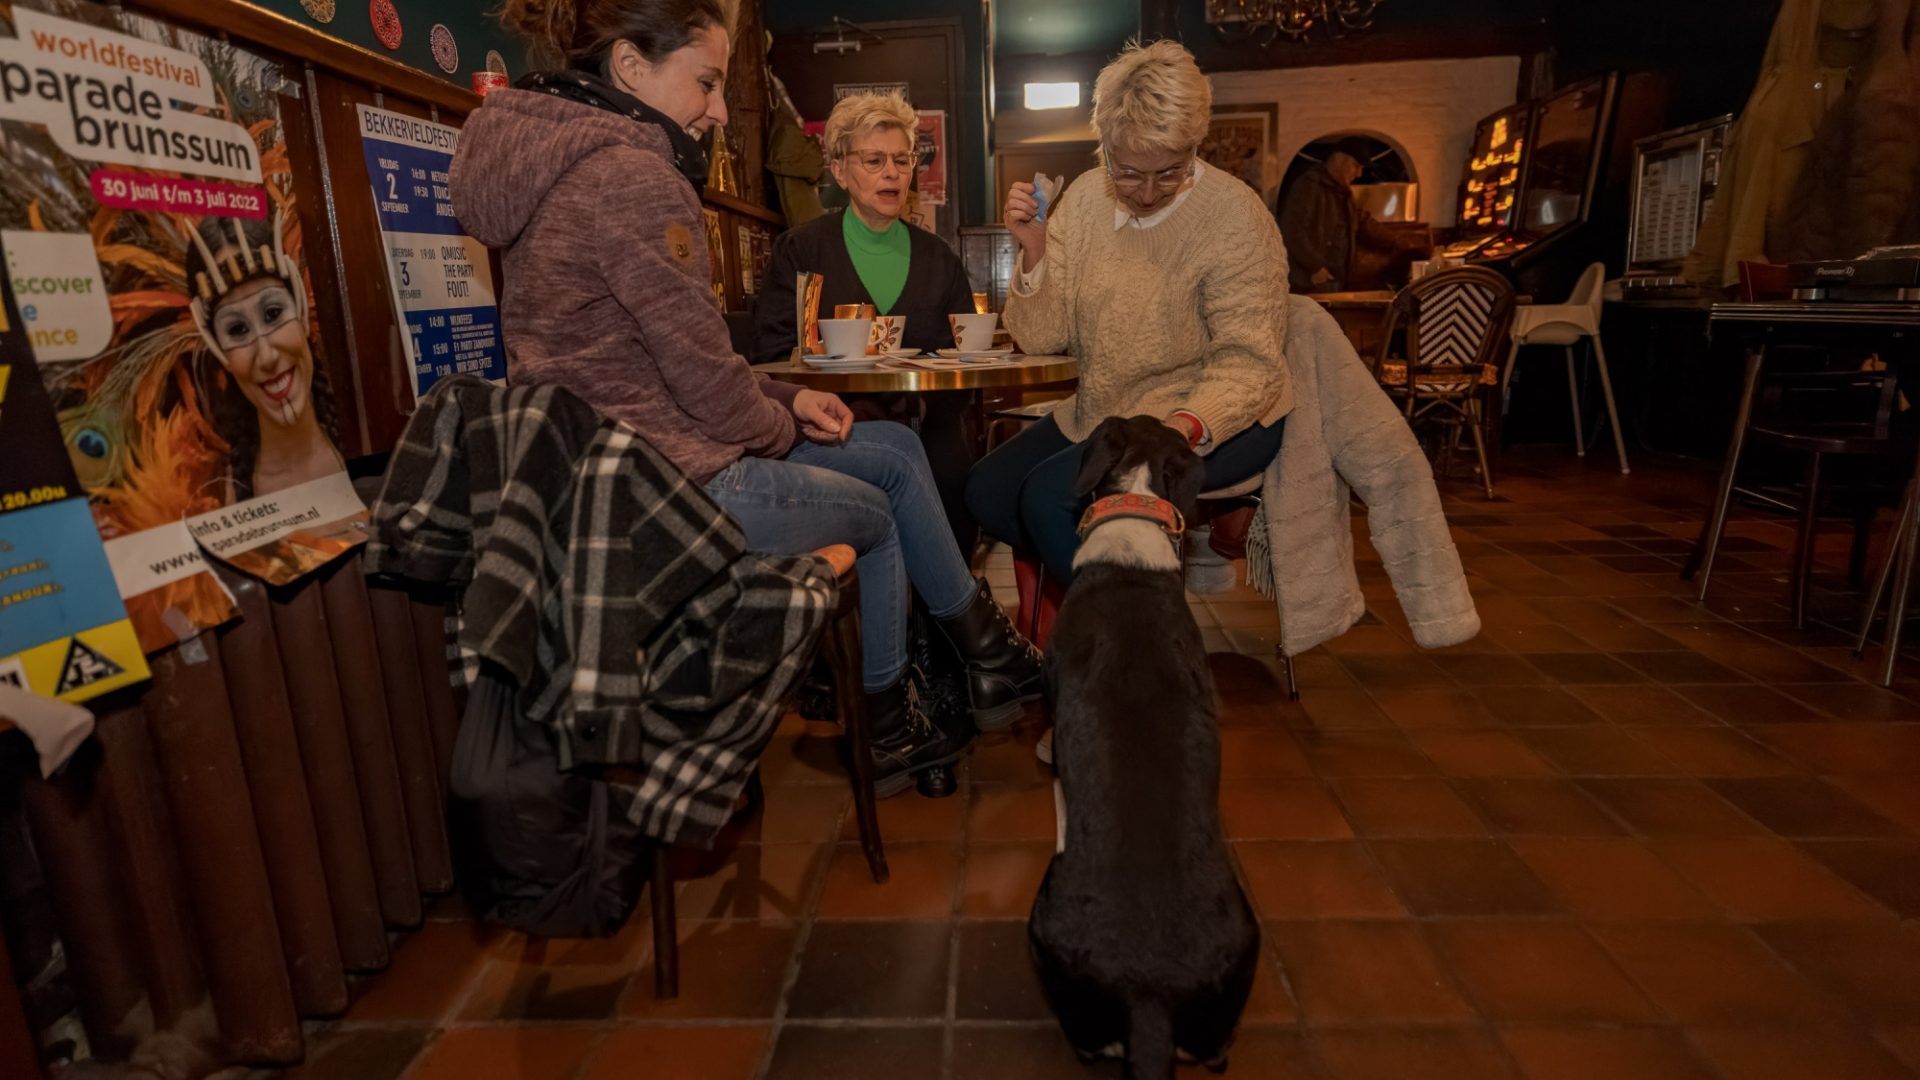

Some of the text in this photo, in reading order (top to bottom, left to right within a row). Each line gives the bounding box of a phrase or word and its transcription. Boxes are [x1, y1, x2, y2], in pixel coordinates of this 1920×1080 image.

[31, 29, 202, 89] worldfestival
[0, 60, 163, 120] parade
[74, 105, 252, 171] brunssum
[101, 178, 127, 198] 30
[131, 182, 158, 202] juni
[194, 188, 204, 205] 3
[206, 189, 227, 208] juli
[229, 193, 260, 211] 2022
[386, 173, 399, 200] 2
[400, 262, 410, 286] 3
[443, 264, 475, 278] THE PARTY
[446, 281, 470, 298] FOUT!
[190, 501, 280, 538] info & tickets:
